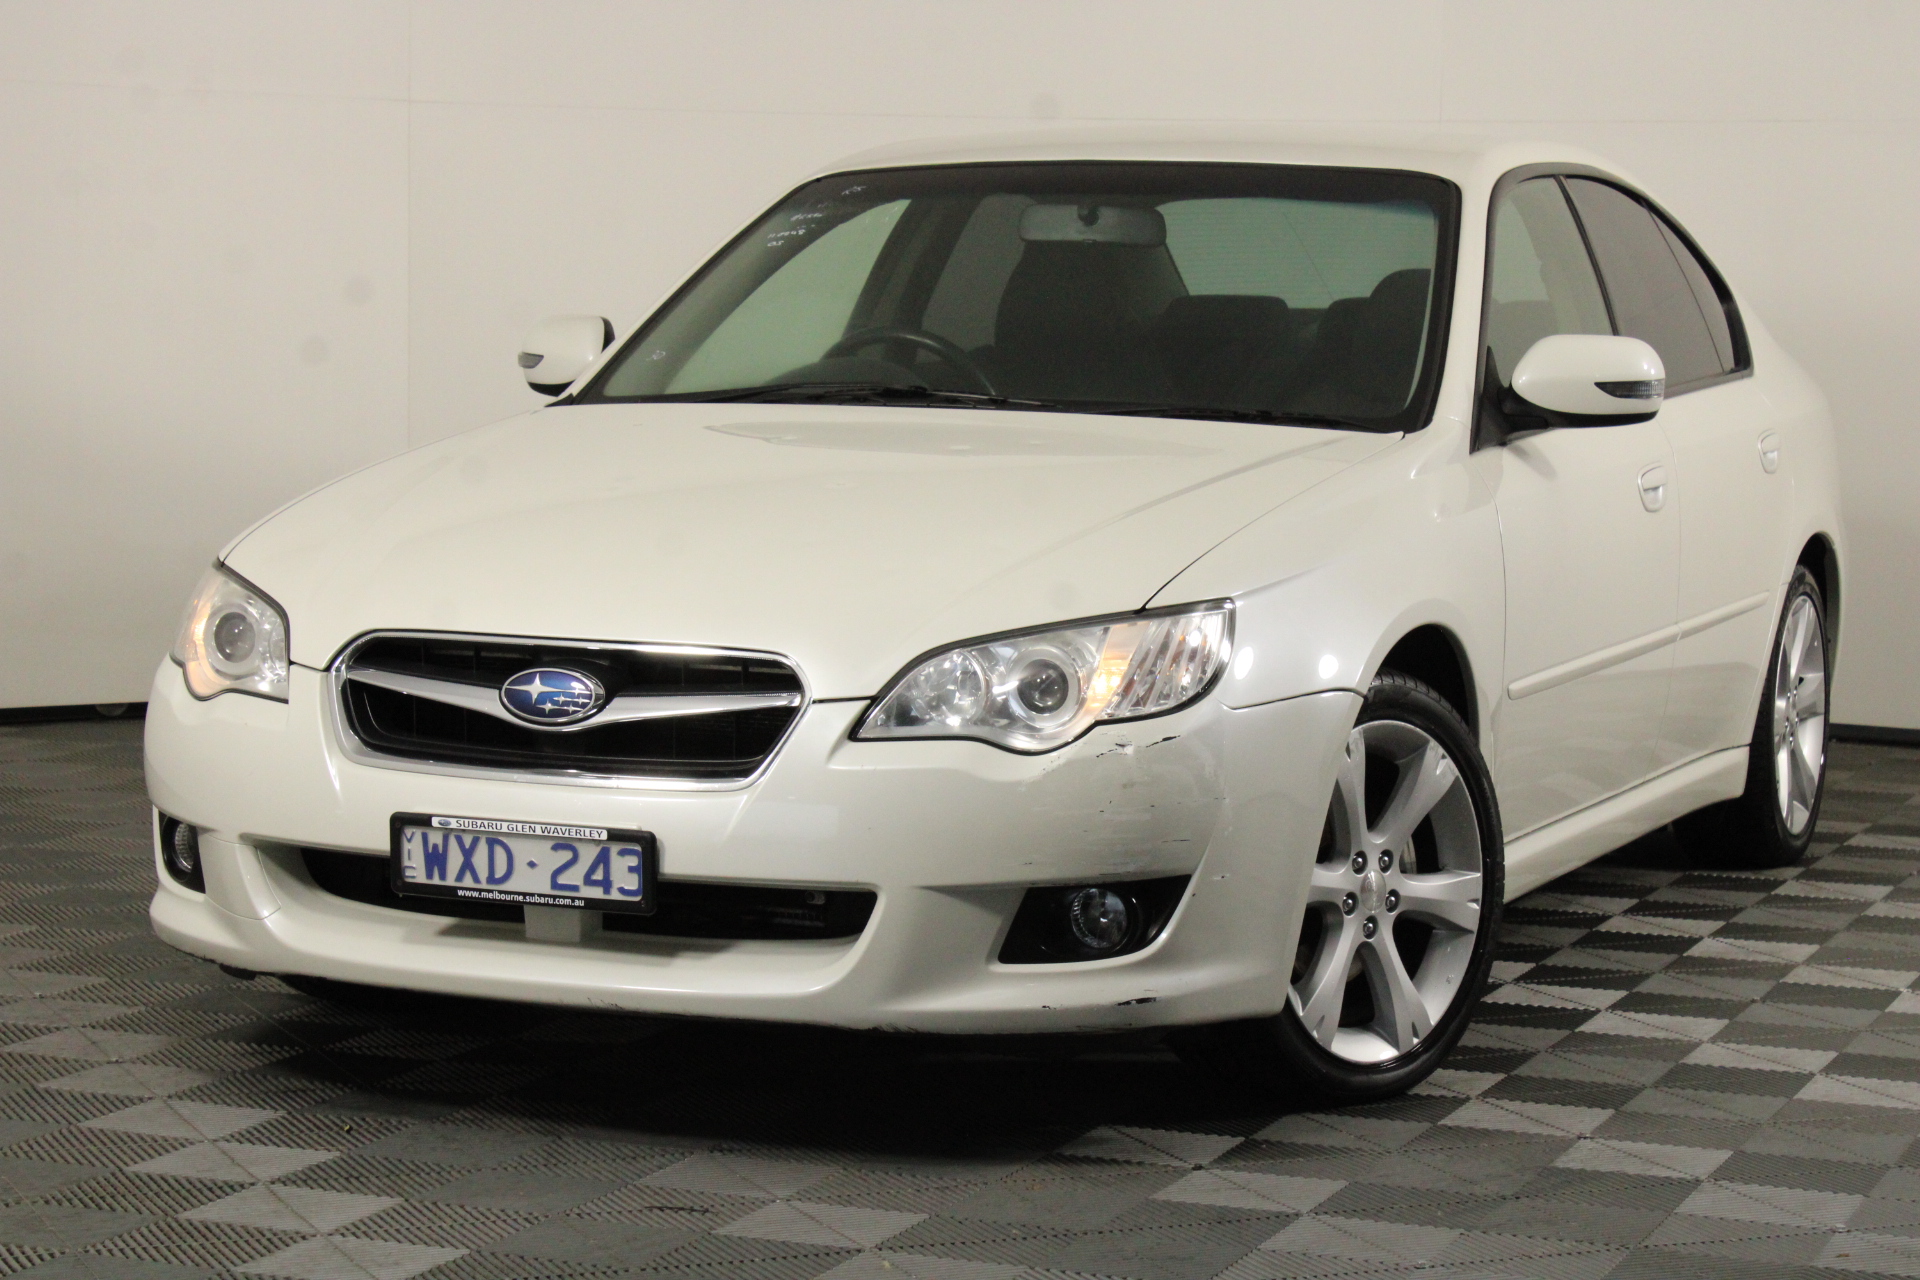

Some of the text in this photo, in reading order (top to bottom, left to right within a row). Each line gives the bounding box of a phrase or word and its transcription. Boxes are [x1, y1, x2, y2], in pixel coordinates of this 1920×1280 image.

[456, 819, 604, 839] SUBARU GLEN WAVERLEY
[421, 832, 642, 897] WXD 243
[457, 889, 585, 907] www.melbourne.subaru.com.au
